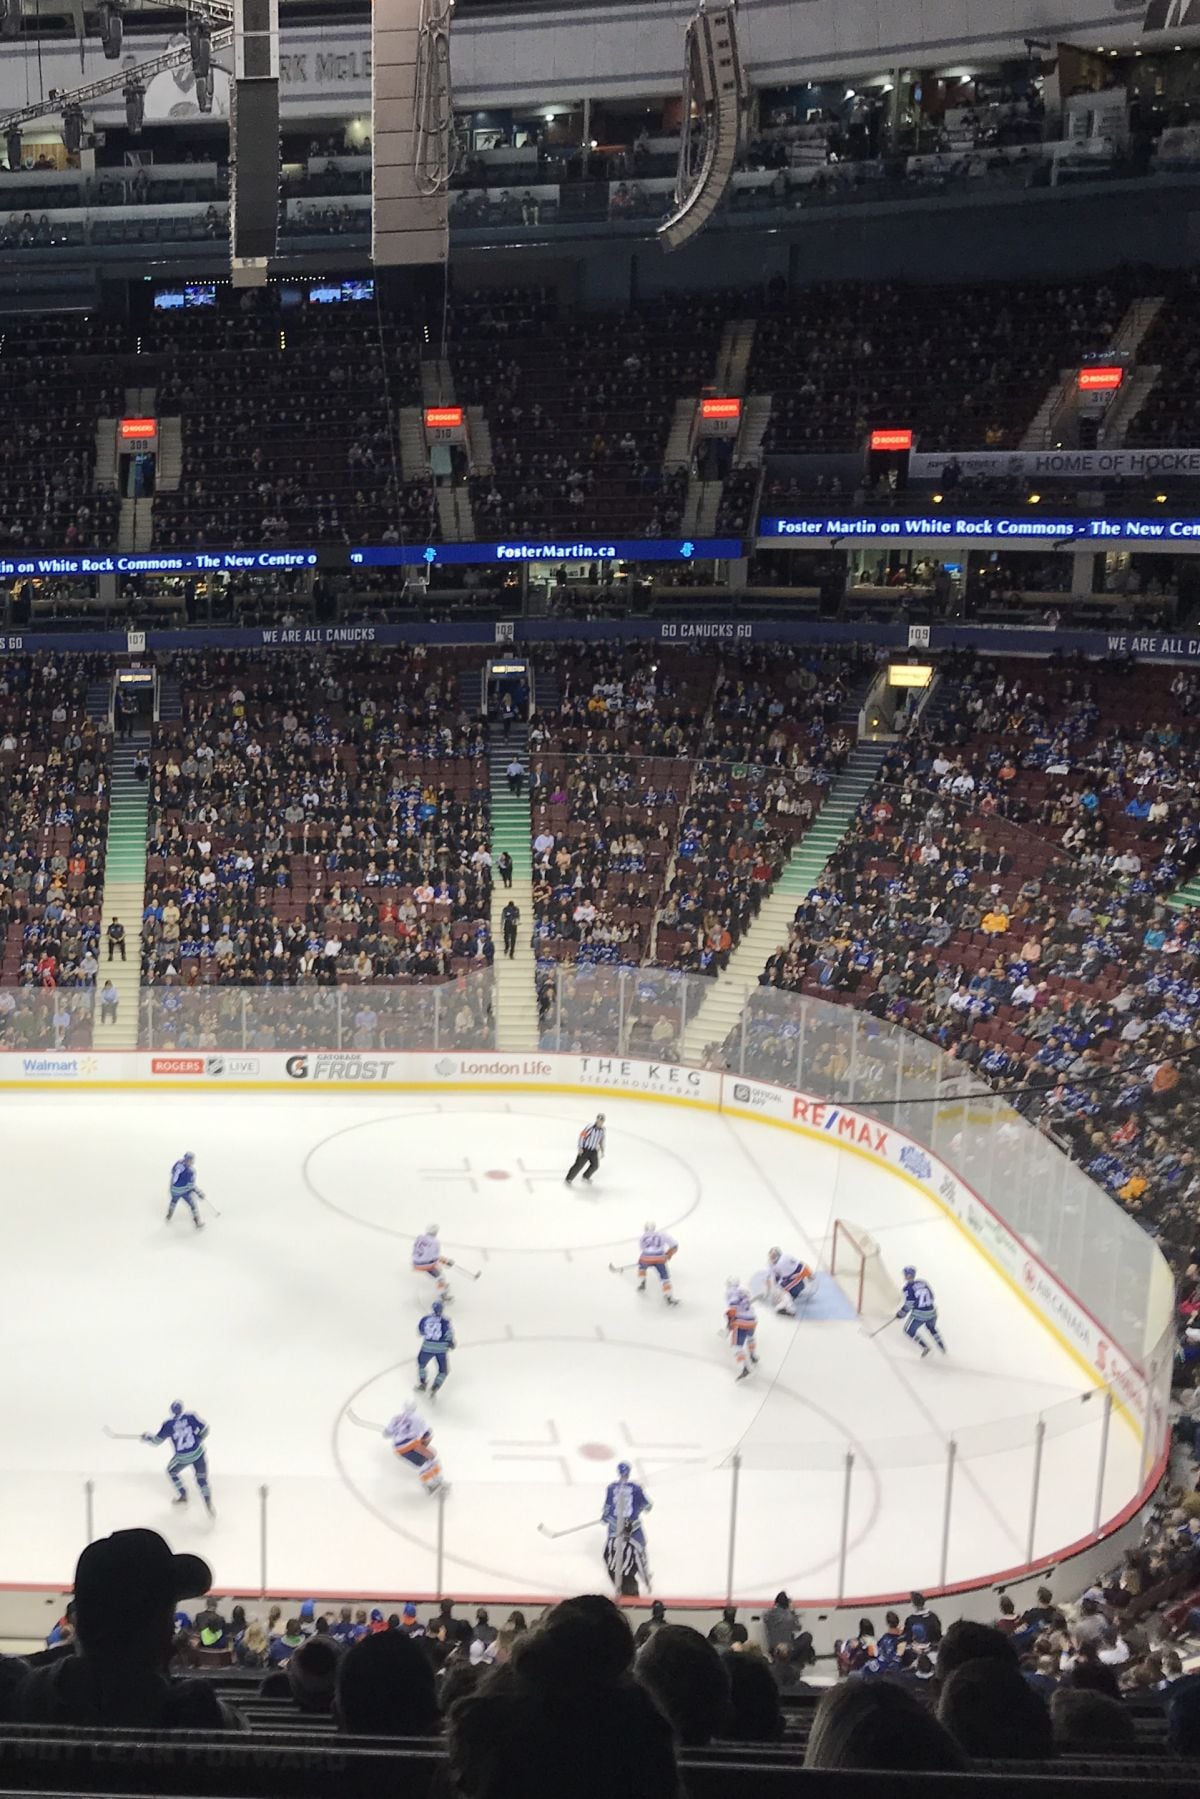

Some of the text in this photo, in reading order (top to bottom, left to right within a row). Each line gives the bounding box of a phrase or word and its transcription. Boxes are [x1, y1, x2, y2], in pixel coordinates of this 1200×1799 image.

[1035, 455, 1093, 473] HOME
[1099, 454, 1125, 471] OF
[777, 518, 822, 534] Foster
[826, 518, 877, 534] Martin
[880, 522, 900, 534] on
[904, 519, 952, 535] White
[956, 519, 993, 536] Rock
[996, 520, 1074, 536] Commons
[1091, 520, 1122, 536] The
[1126, 521, 1165, 537] New
[497, 543, 616, 559] FosterMartin.ca
[18, 564, 36, 574] on
[38, 559, 78, 573] White
[82, 558, 115, 572] Rock
[117, 557, 183, 571] Commons
[196, 555, 221, 569] The
[224, 553, 256, 567] New
[258, 552, 304, 566] Centre
[262, 628, 375, 643] WE ARE ALL CANUCKS
[661, 624, 752, 637] GO CANUCKS GO
[910, 628, 928, 640] 109
[8, 637, 23, 650] GO
[128, 633, 145, 645] 107
[1107, 637, 1127, 653] WE
[1131, 638, 1156, 653] ARE
[1160, 639, 1184, 654] ALL
[23, 1059, 78, 1072] Walmart
[155, 1060, 256, 1072] ROGERS LIVE
[312, 1060, 395, 1080] FROST
[460, 1060, 553, 1076] London Life
[580, 1057, 702, 1086] THE KEG
[791, 1096, 889, 1156] RE/MAX
